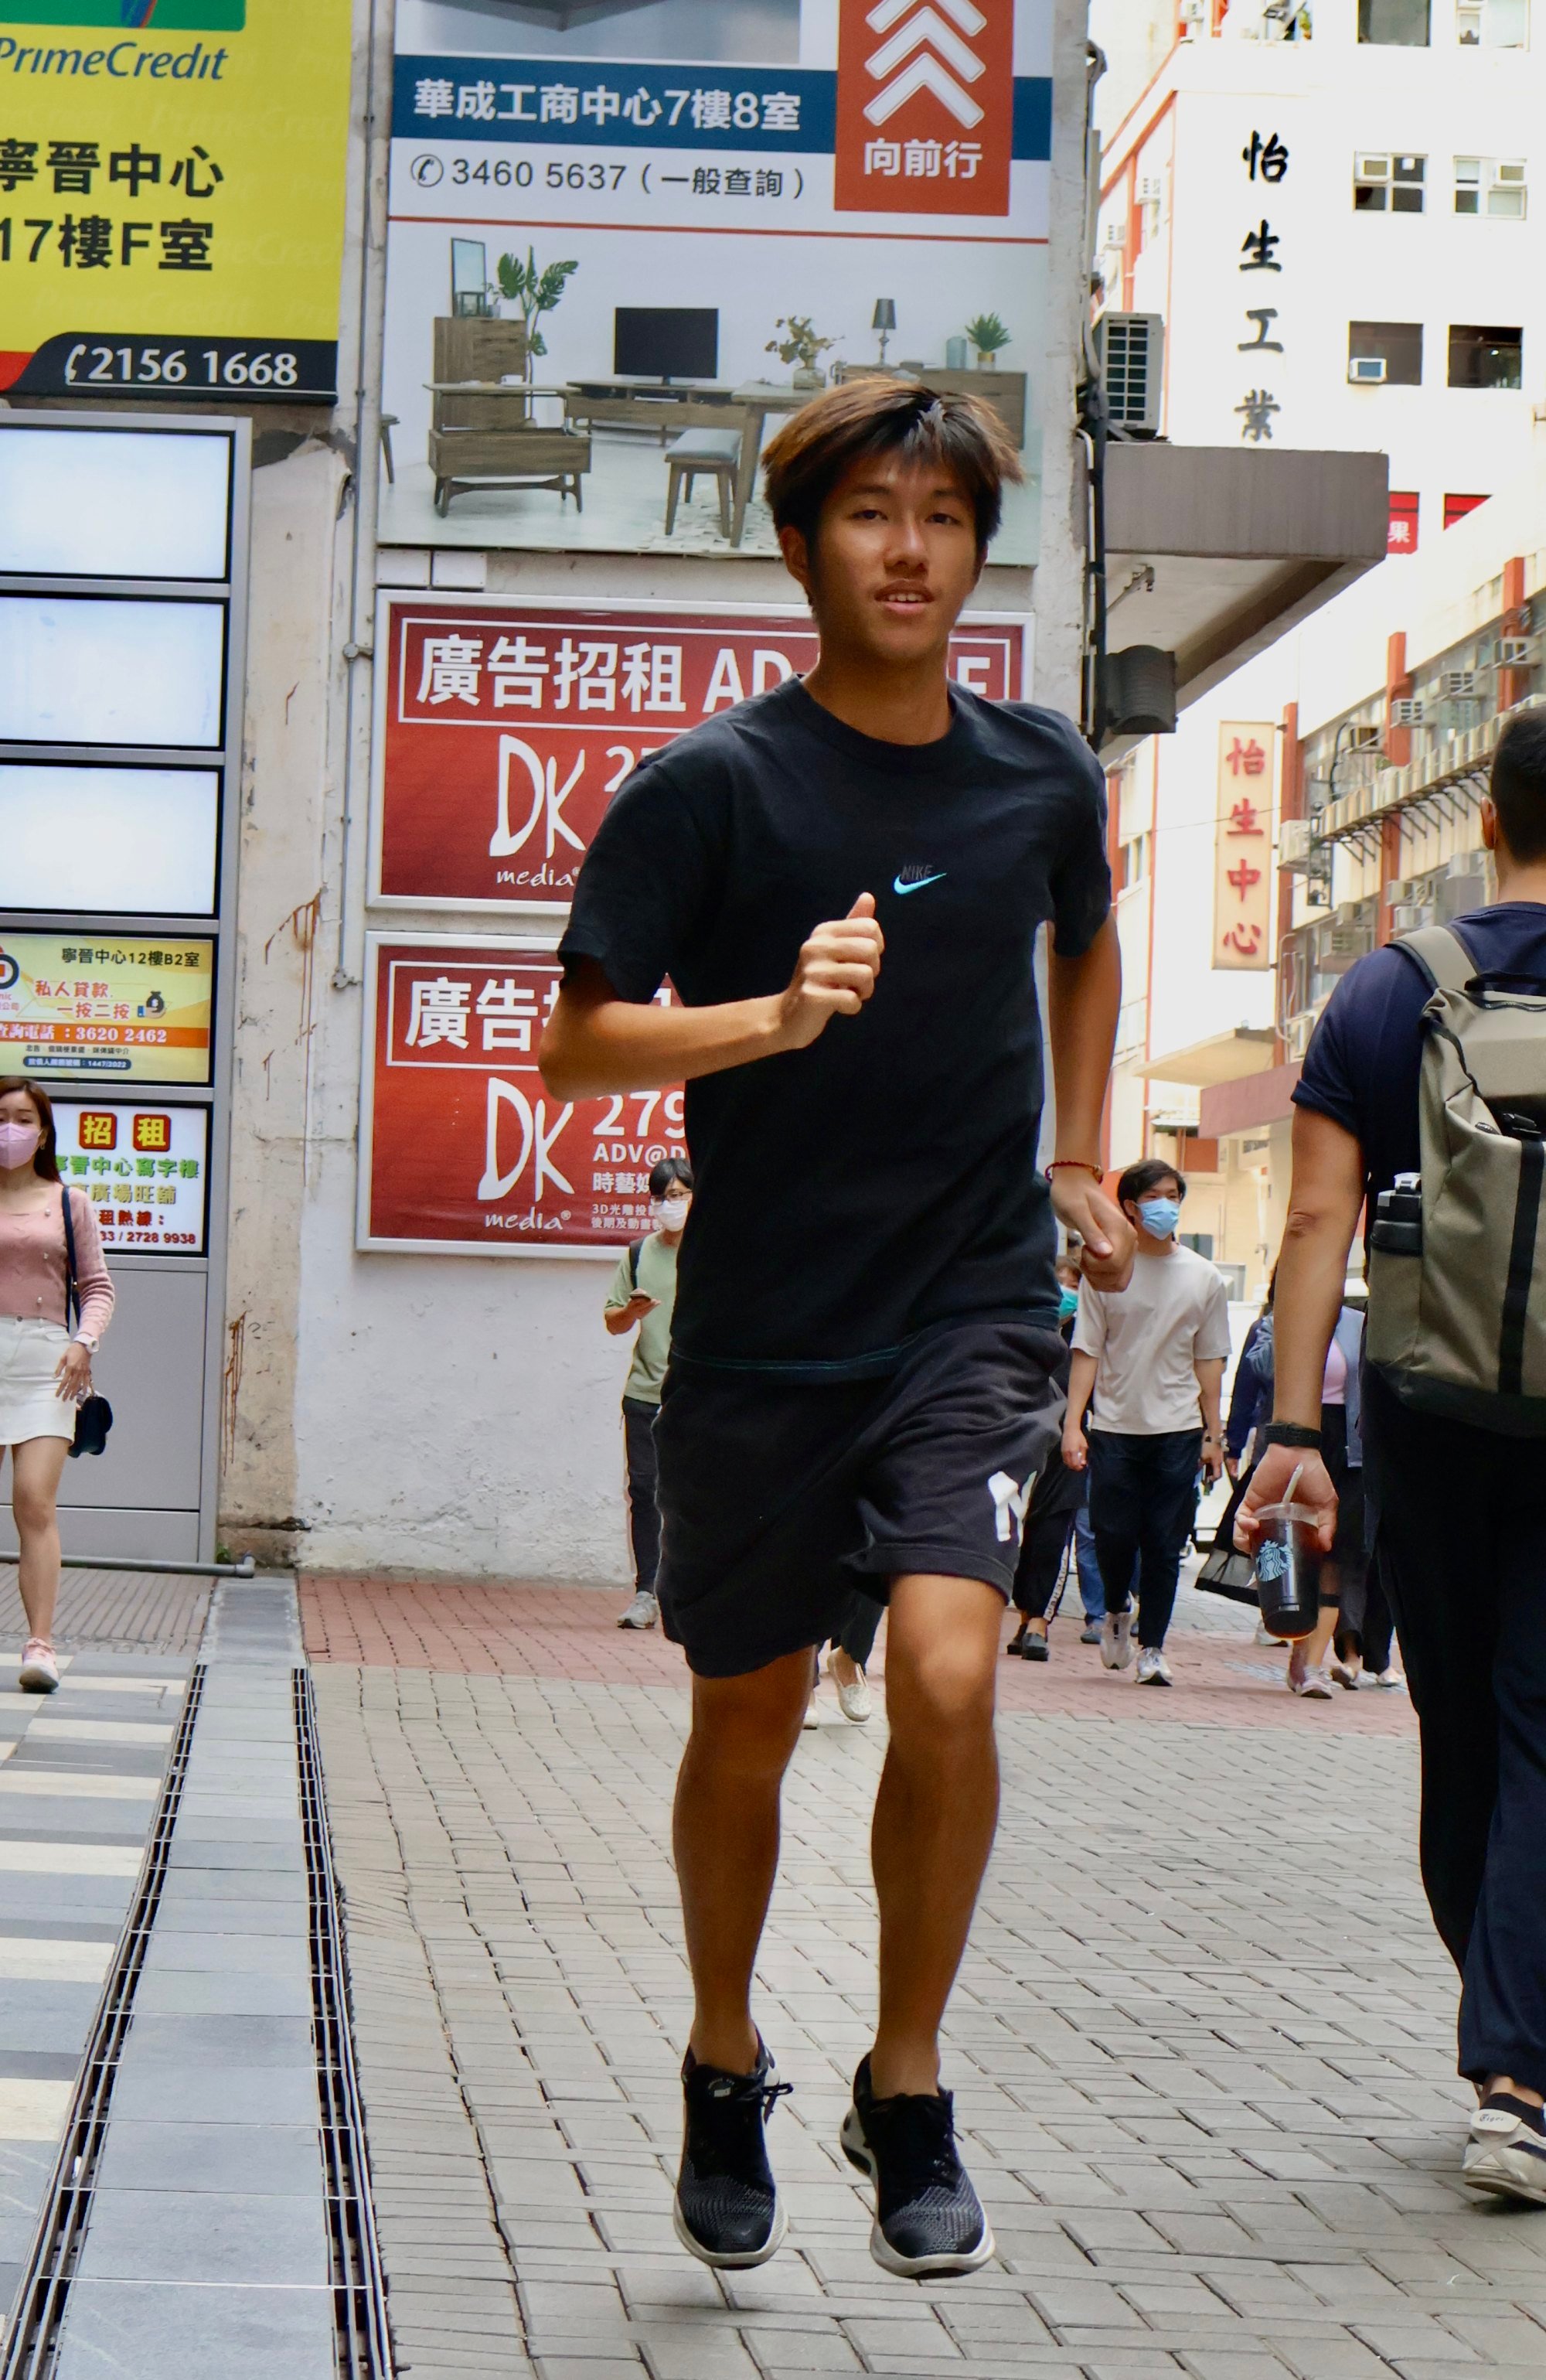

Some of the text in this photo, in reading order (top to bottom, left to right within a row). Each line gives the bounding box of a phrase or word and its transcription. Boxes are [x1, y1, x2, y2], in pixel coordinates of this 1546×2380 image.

[413, 78, 802, 131] 華成工商中心7樓8室
[451, 159, 534, 187] 3460
[546, 163, 627, 192] 5637
[863, 138, 984, 179] 向前行
[1234, 129, 1289, 442] 怡生工業
[89, 347, 298, 385] 2156 1668
[416, 634, 686, 713] 廣告招租
[702, 647, 821, 714] AD
[489, 734, 587, 859] DK
[1223, 737, 1265, 956] 怡生中心
[901, 864, 934, 881] NIKE
[56, 1002, 131, 1019] 一按二按
[75, 1027, 118, 1042] 3620
[124, 1029, 168, 1044] 2462
[478, 1077, 575, 1202] DK
[127, 1232, 159, 1243] 2728
[163, 1233, 196, 1244] 9938
